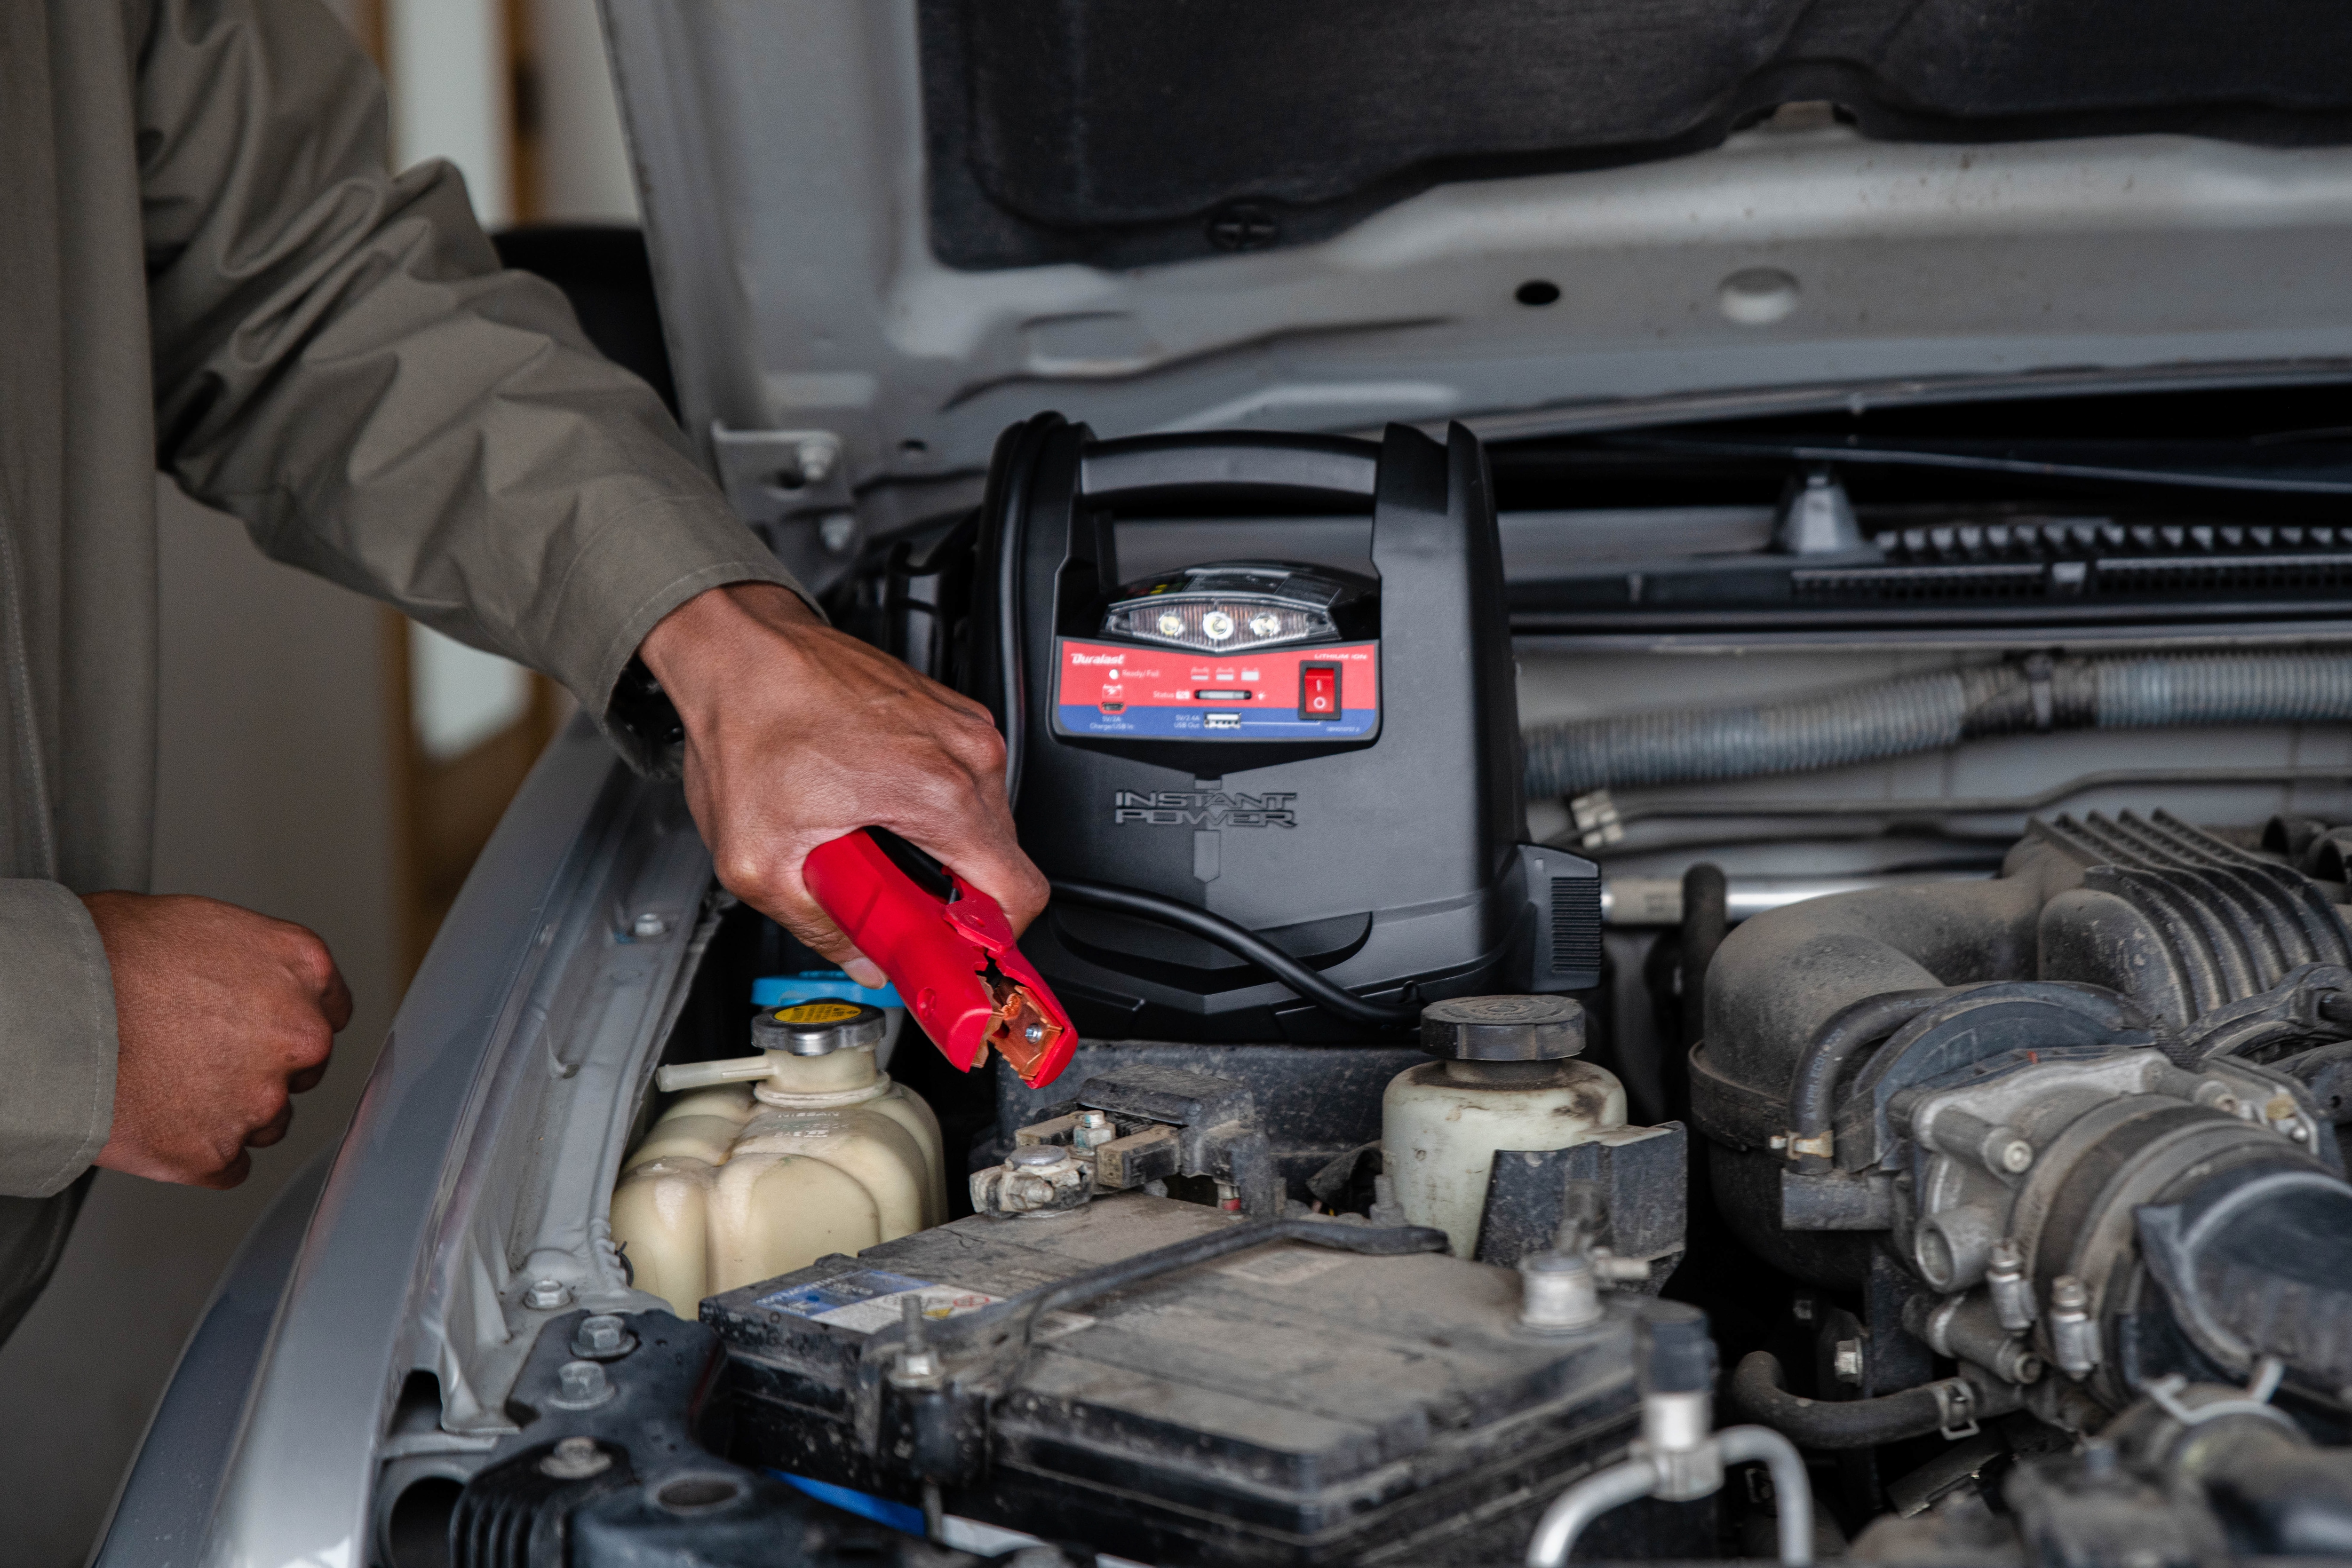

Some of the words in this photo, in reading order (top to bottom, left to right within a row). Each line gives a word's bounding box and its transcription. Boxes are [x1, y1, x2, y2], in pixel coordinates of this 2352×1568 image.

[1071, 653, 1125, 665] Duralast
[1115, 791, 1297, 808] INSTANT
[1115, 808, 1298, 828] POWER
